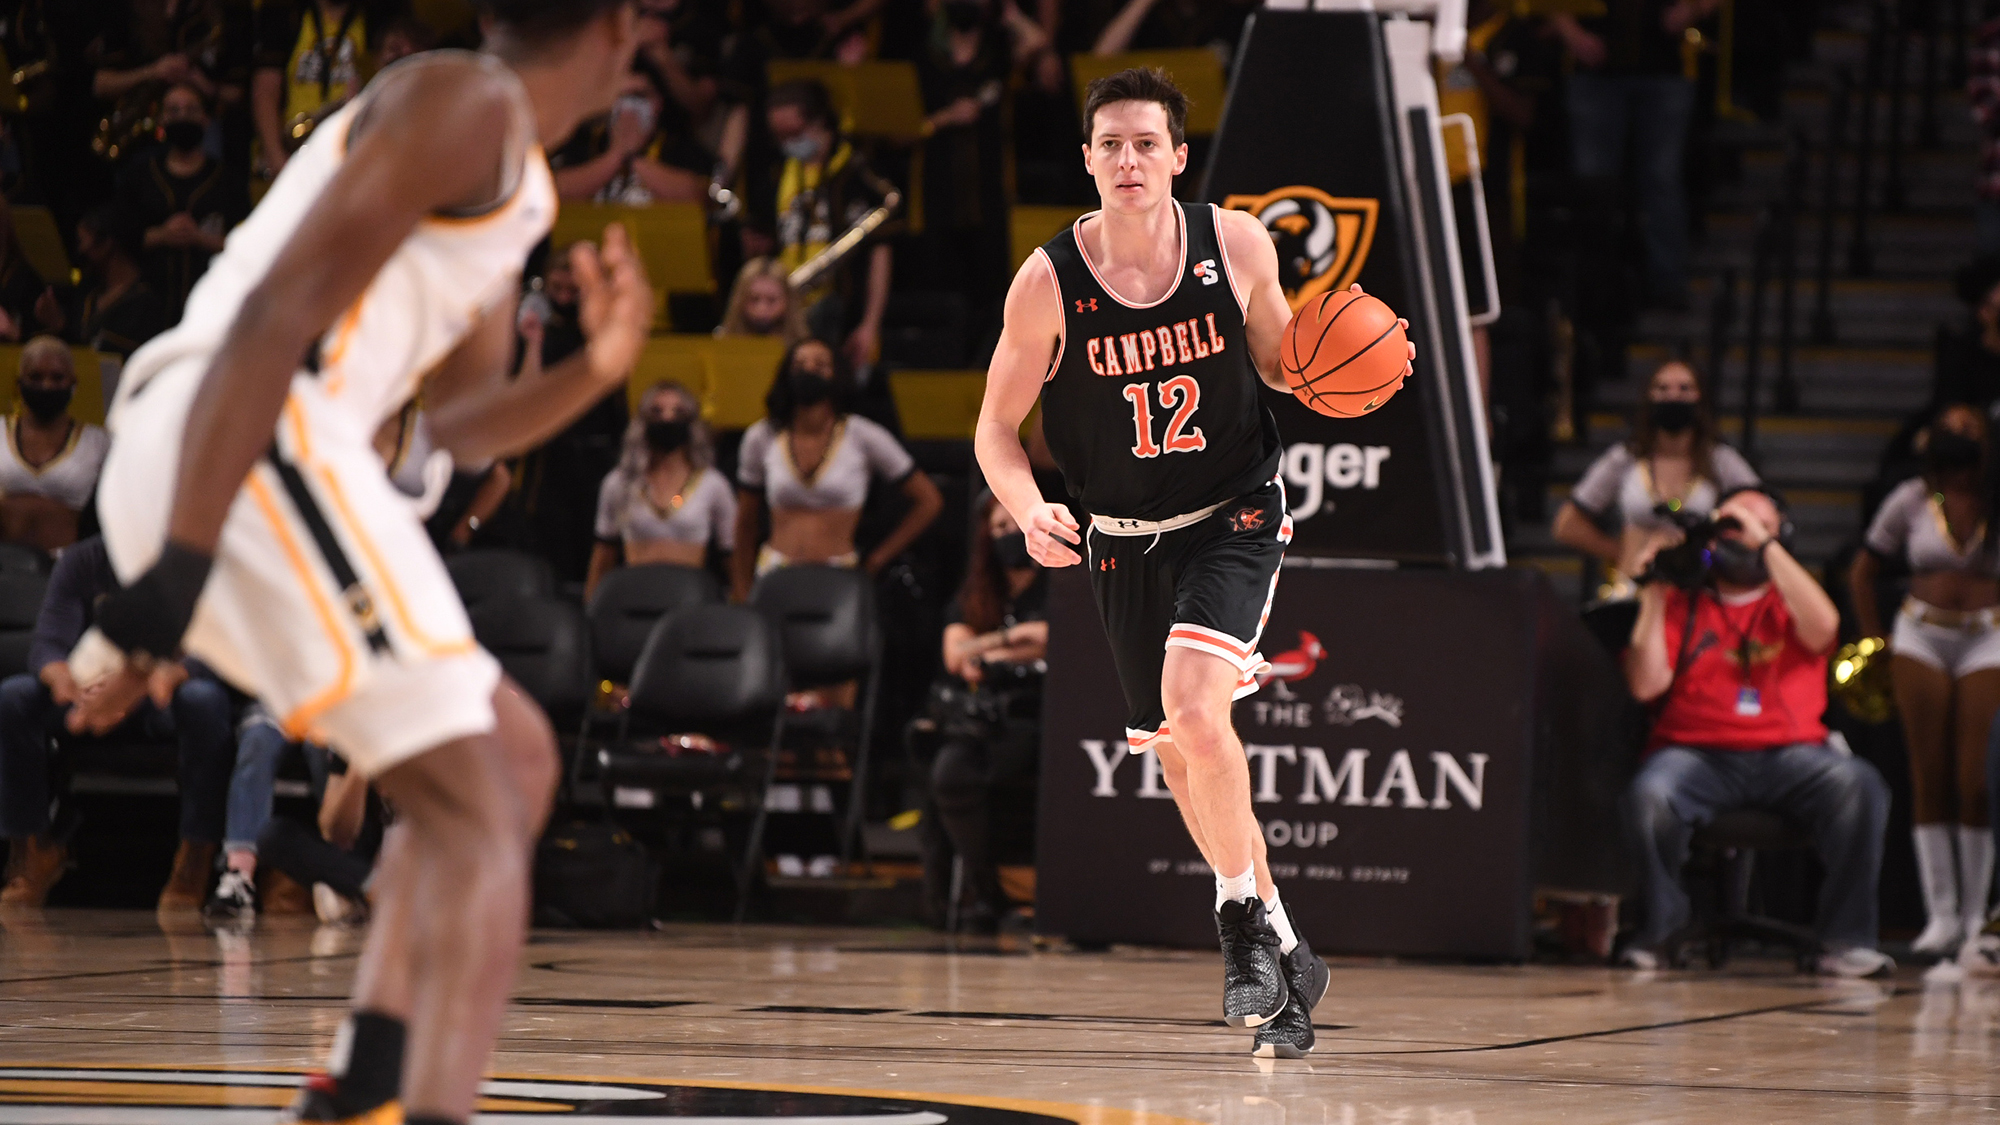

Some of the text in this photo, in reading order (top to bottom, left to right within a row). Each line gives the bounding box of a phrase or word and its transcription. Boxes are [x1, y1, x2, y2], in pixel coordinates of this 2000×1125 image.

[1086, 312, 1226, 376] CAMPBELL
[1122, 374, 1207, 459] 12
[1279, 442, 1391, 522] ger
[1253, 702, 1312, 727] THE
[1079, 739, 1490, 811] YETMAN
